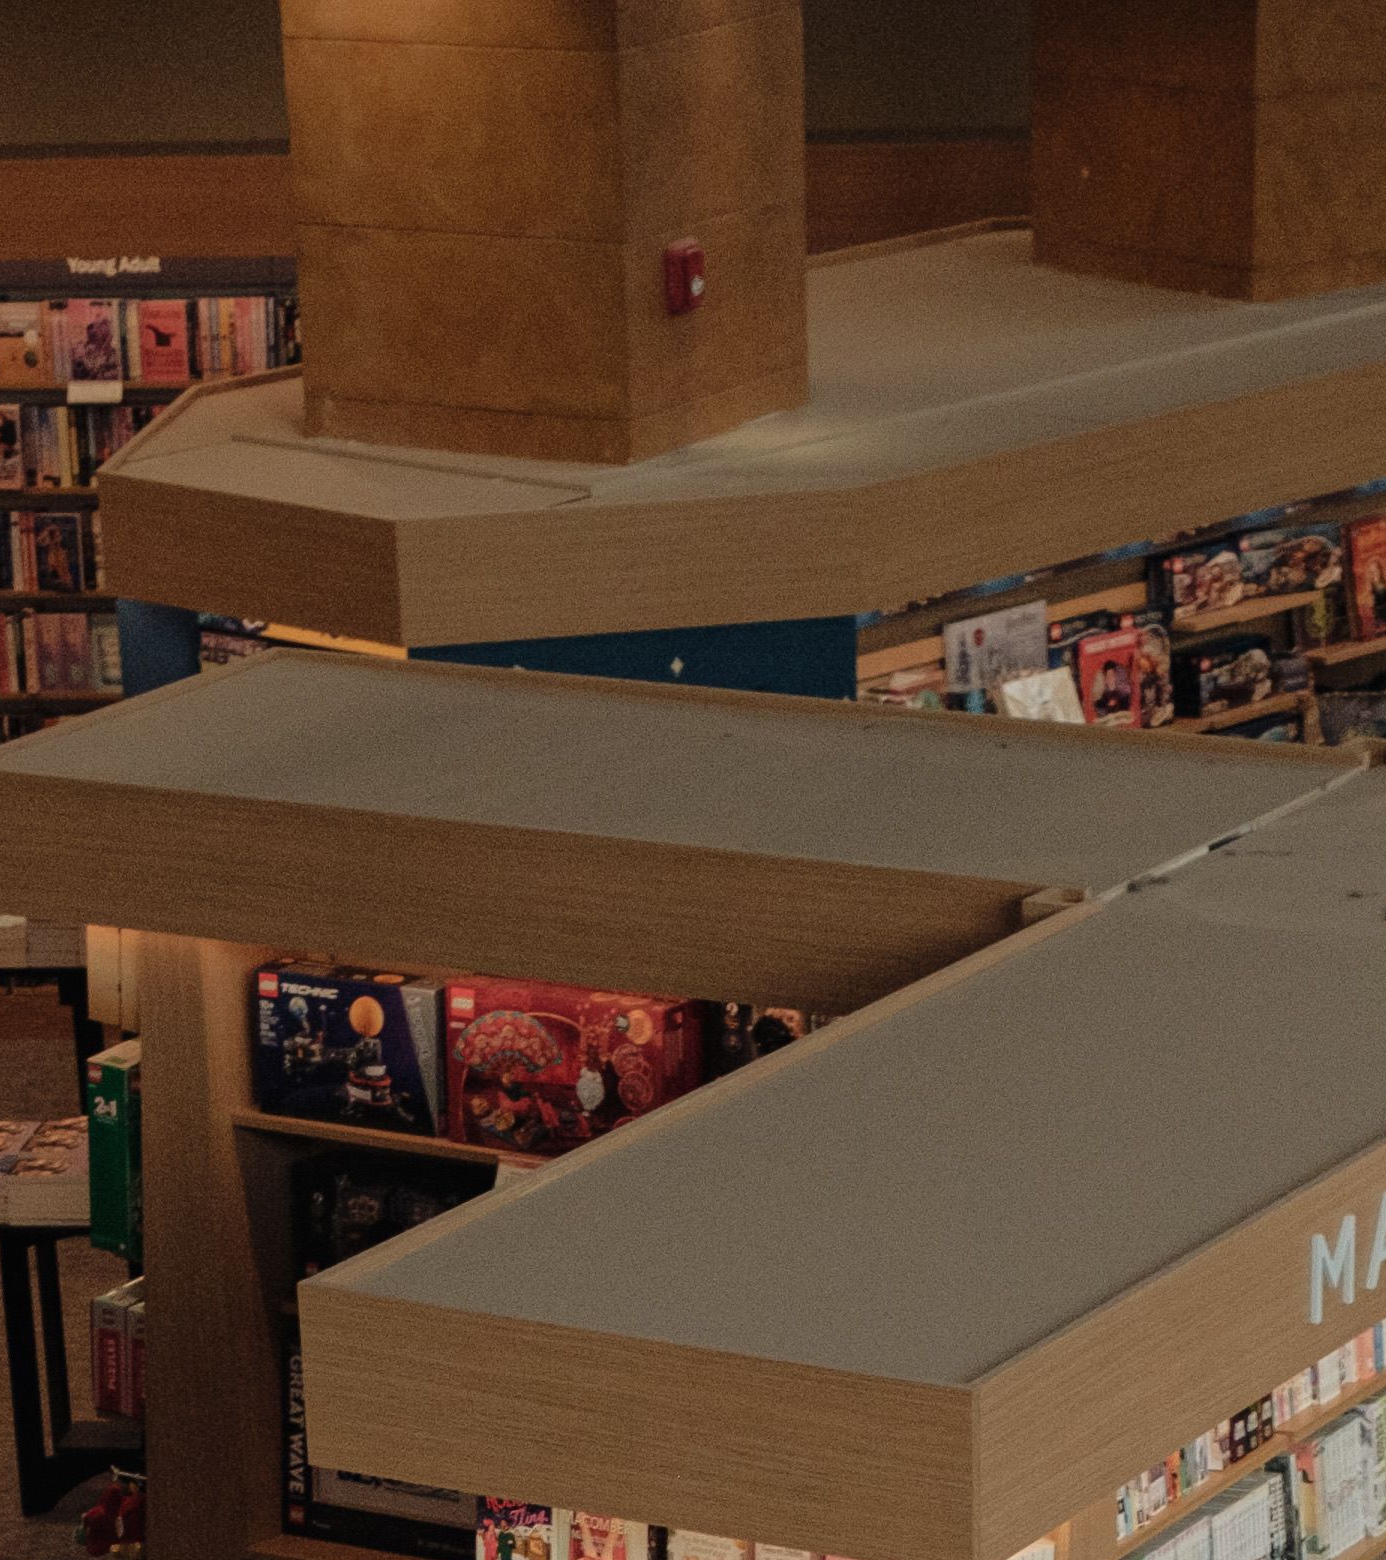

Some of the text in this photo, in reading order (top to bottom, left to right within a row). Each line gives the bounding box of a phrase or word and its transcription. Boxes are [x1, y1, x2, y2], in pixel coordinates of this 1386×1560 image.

[67, 255, 161, 277] Young Adult
[280, 981, 340, 1003] TECHNIC
